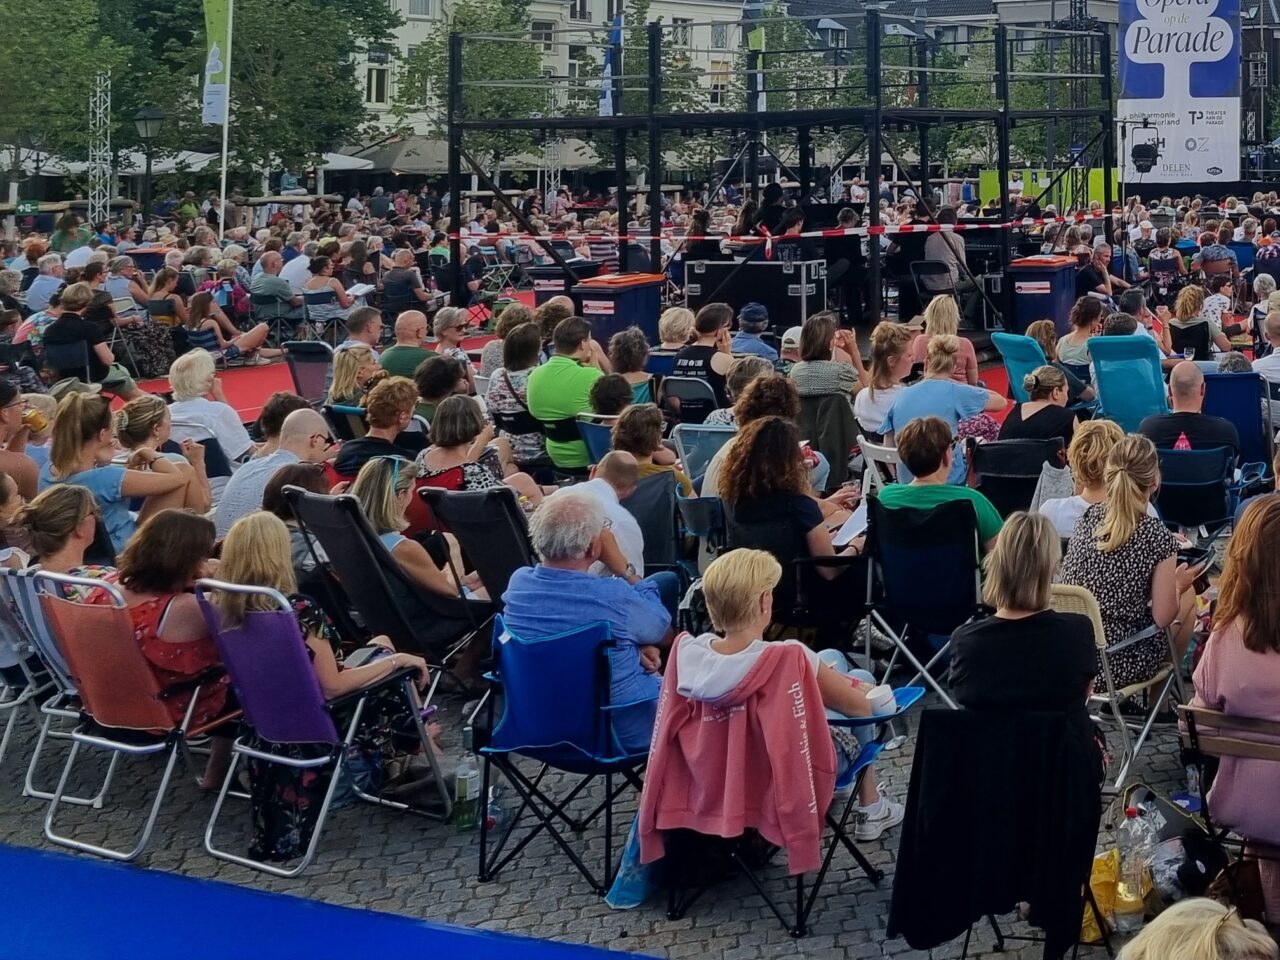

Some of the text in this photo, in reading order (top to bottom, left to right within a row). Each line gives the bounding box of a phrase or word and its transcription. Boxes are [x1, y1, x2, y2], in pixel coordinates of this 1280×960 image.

[1163, 12, 1190, 27] op de
[1132, 22, 1225, 54] Parade
[1129, 111, 1176, 120] philharmonie
[1162, 163, 1191, 172] DELEN
[787, 680, 806, 719] Fitch
[800, 720, 807, 729] &
